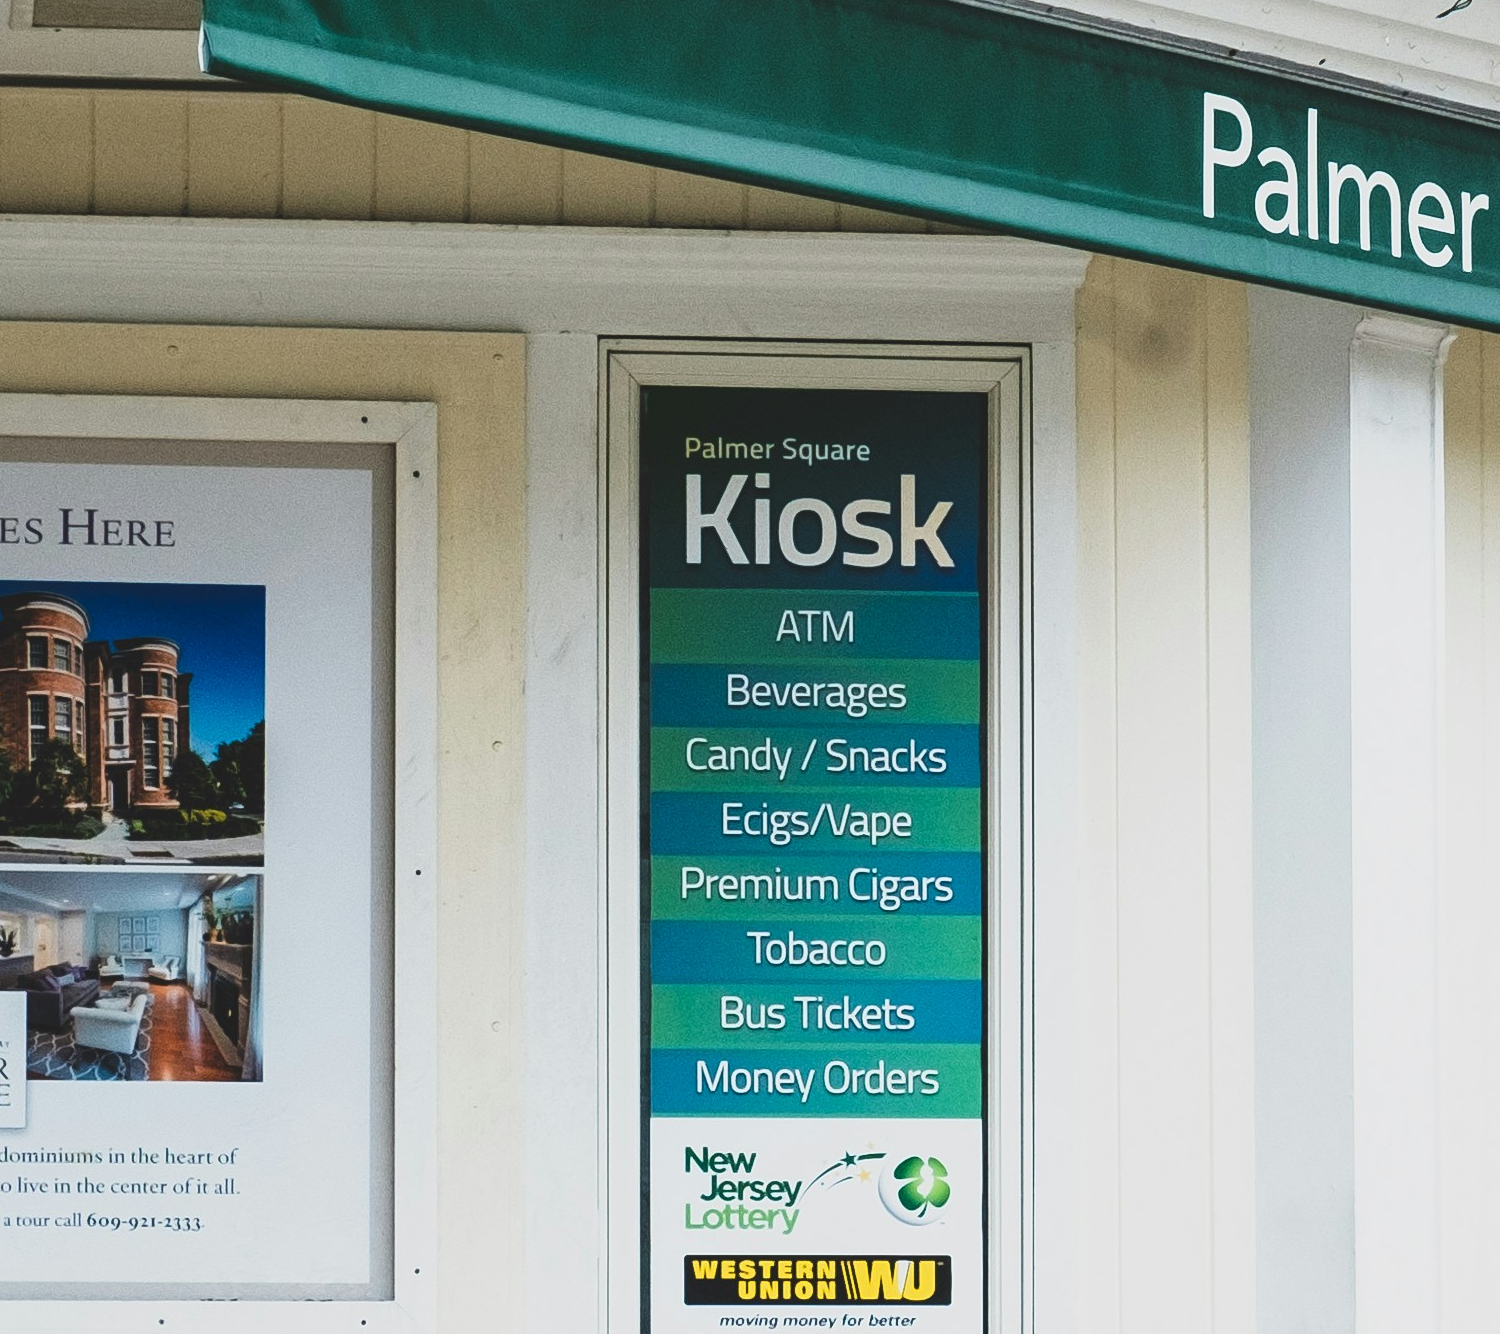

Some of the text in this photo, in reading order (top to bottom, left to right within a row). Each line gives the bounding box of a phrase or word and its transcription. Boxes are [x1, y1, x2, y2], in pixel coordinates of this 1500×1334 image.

[1202, 91, 1490, 273] Palmer
[686, 438, 870, 465] Palmer Square
[59, 509, 175, 547] HERE
[686, 473, 954, 567] Kiosk
[777, 610, 853, 642] ATM
[728, 674, 906, 717] Beverages
[687, 738, 946, 780] Candy / Snacks
[723, 803, 911, 845] Ecigs/Vape
[682, 867, 953, 910] Premium Cigars
[747, 931, 885, 965] Tobacco
[721, 996, 914, 1029] Bus Tickets
[697, 1060, 939, 1102] Money Orders
[108, 1147, 126, 1164] in
[132, 1148, 158, 1163] the
[166, 1148, 210, 1164] heart
[218, 1148, 238, 1164] of
[686, 1147, 756, 1173] New
[19, 1177, 48, 1193] live
[55, 1179, 70, 1193] in
[78, 1178, 104, 1193] the
[111, 1183, 167, 1193] center
[172, 1177, 195, 1194] of
[198, 1179, 207, 1194] it
[214, 1178, 241, 1194] all.
[701, 1175, 802, 1207] Jersey
[4, 1218, 10, 1226] a
[17, 1217, 50, 1226] tour
[55, 1213, 81, 1226] call
[87, 1213, 205, 1231] 609-921-2333.
[686, 1204, 799, 1234] Lottery
[692, 1260, 835, 1279] WESTERN
[739, 1281, 836, 1299] UNION
[720, 1314, 916, 1330] moving money for better
